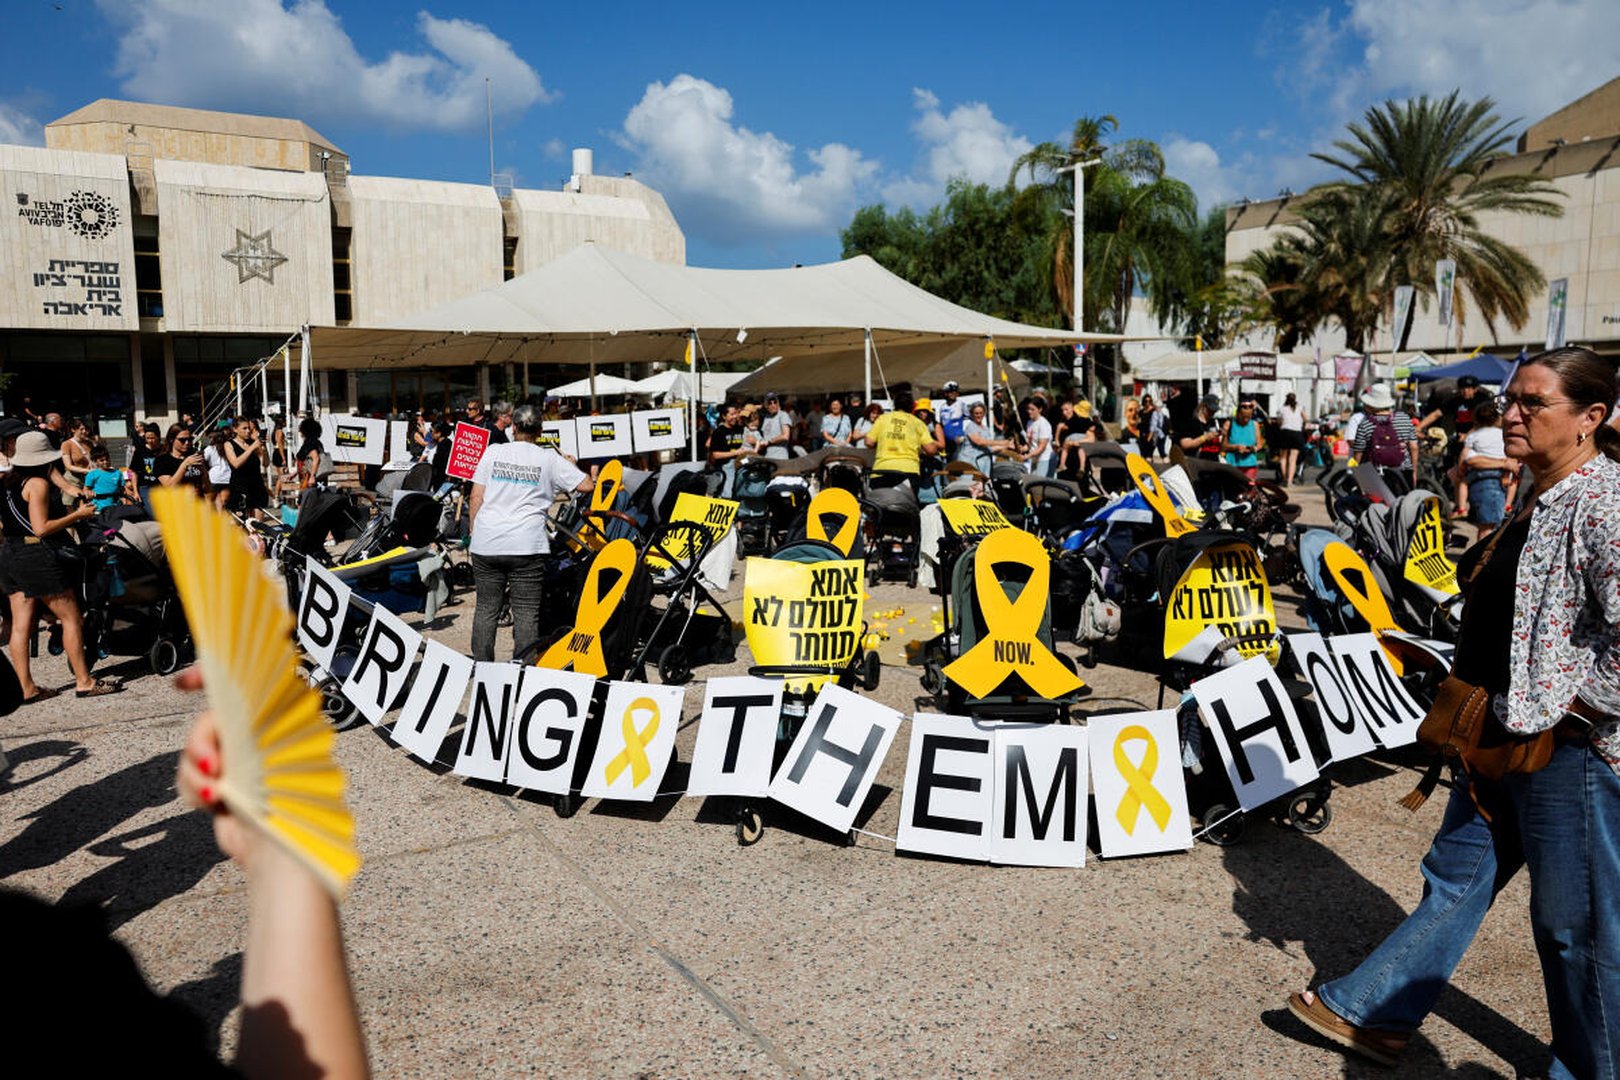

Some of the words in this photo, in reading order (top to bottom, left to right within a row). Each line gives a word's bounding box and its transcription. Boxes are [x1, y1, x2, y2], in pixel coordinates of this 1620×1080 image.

[19, 208, 41, 217] AVIV
[33, 201, 50, 209] TEL
[41, 210, 64, 218] אביב
[48, 259, 119, 274] ספריית
[86, 289, 122, 302] בית
[43, 301, 122, 316] אריאלה
[705, 503, 734, 525] אמא
[1208, 550, 1262, 583] אמא
[810, 567, 859, 597] אמא
[752, 595, 784, 626] לא
[1173, 584, 1193, 620] לא
[1198, 580, 1265, 619] לעולם
[788, 596, 858, 629] לעולם
[566, 632, 595, 655] NOW.
[789, 630, 856, 661] תוותר
[994, 640, 1035, 666] NOW.
